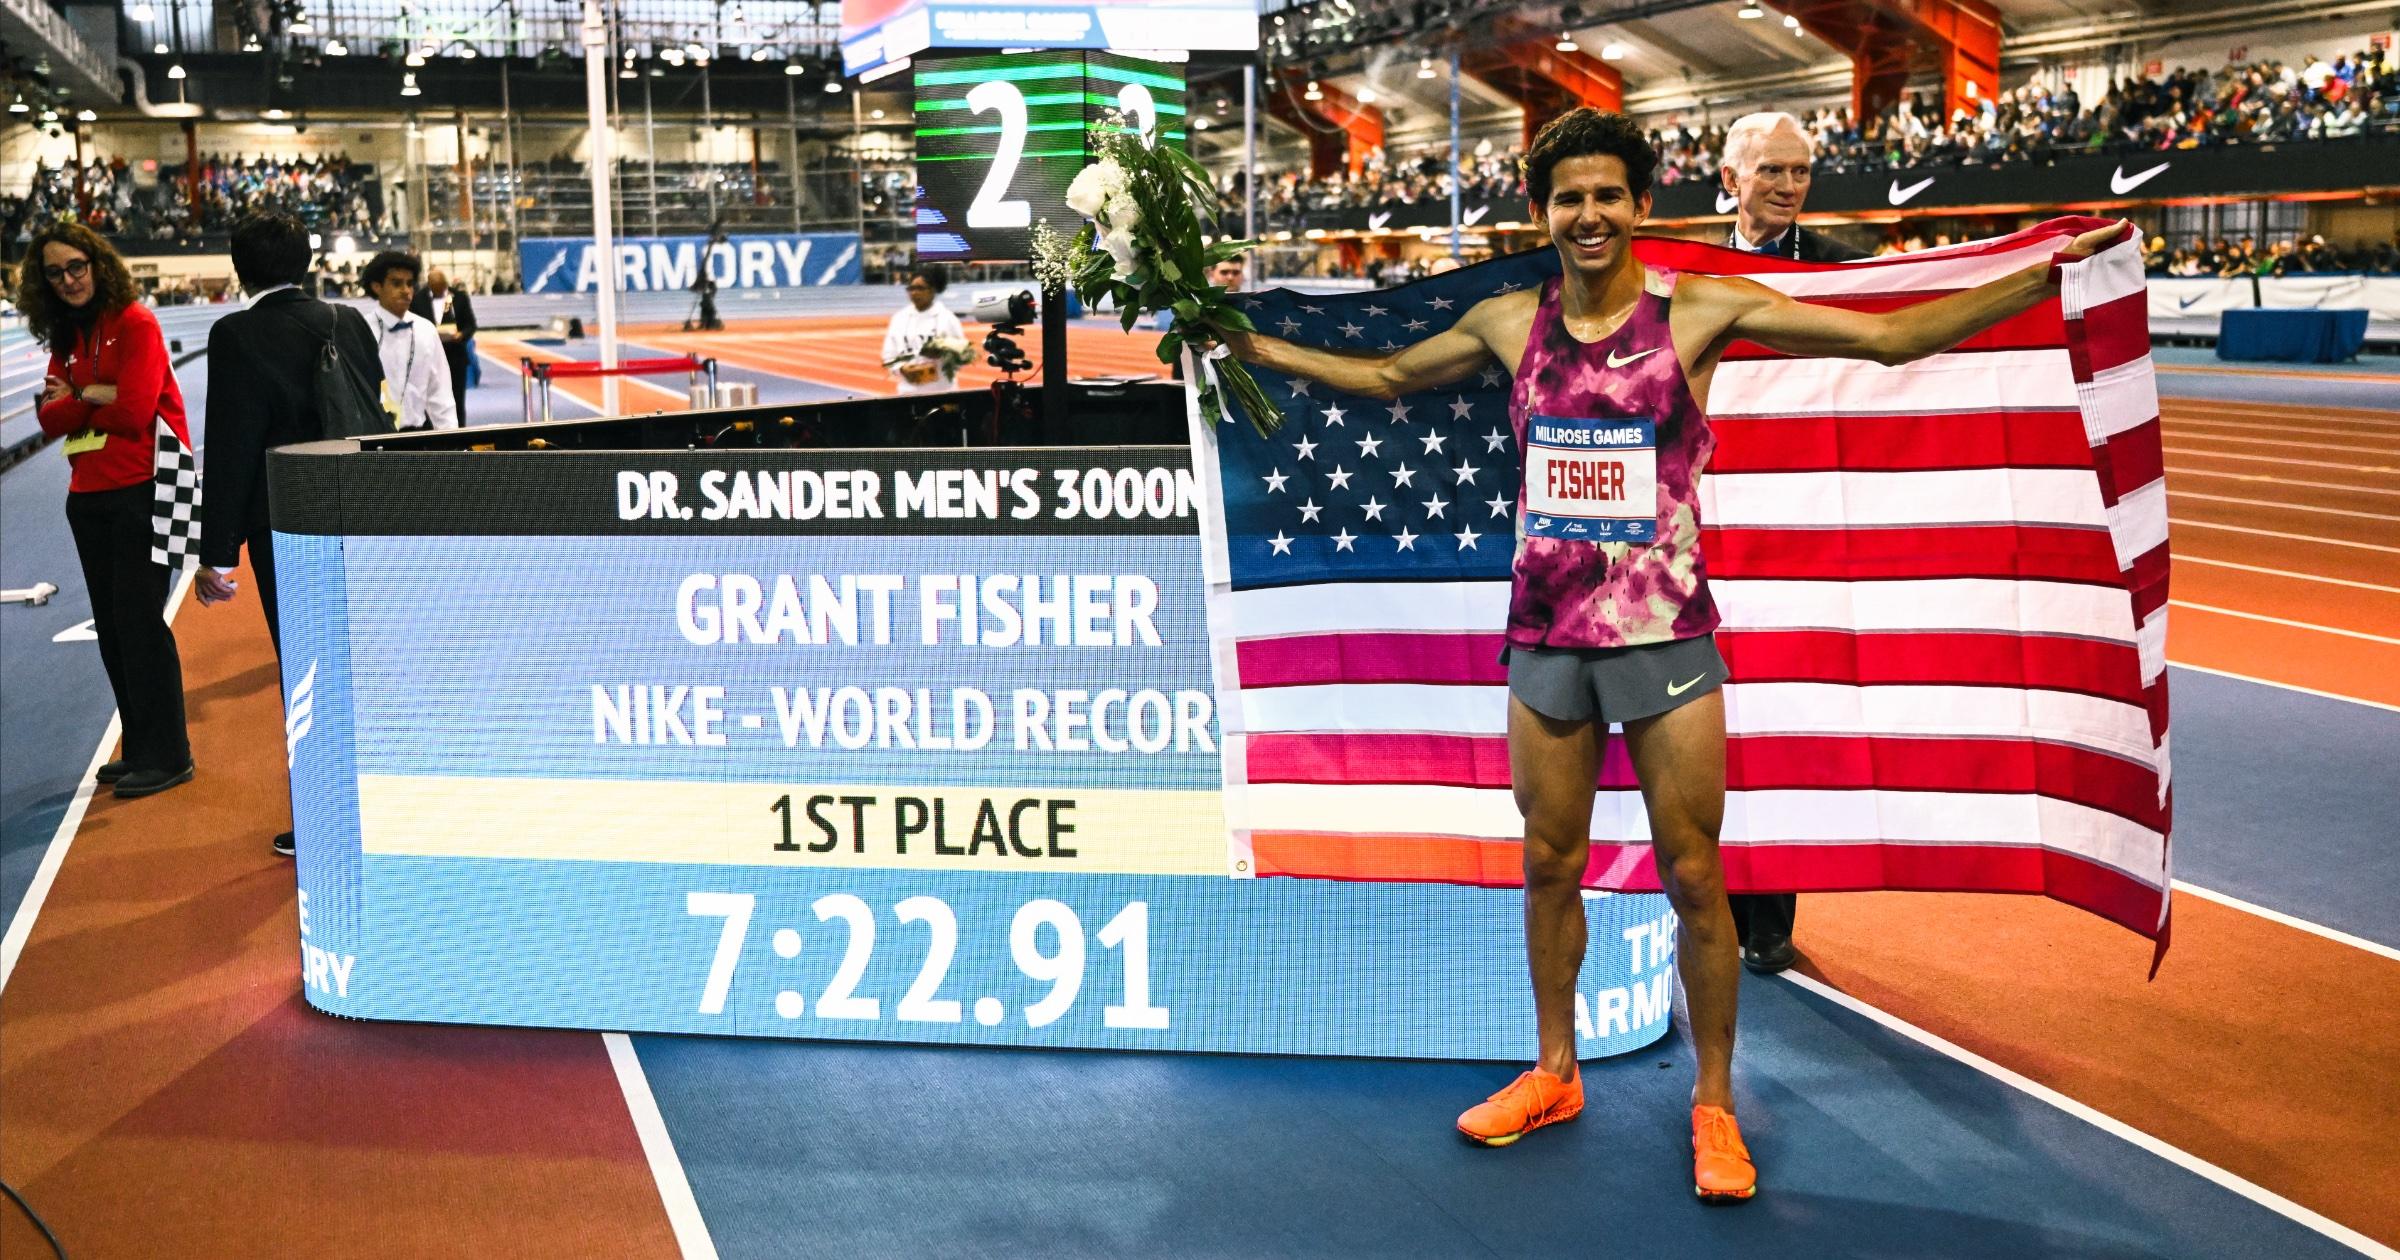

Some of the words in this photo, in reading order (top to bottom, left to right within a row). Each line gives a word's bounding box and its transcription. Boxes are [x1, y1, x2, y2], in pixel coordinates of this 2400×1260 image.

[966, 80, 1031, 228] 2
[575, 240, 812, 293] ARMORY
[1535, 425, 1590, 445] MILLROSE
[1593, 427, 1643, 445] GAMES
[617, 470, 693, 520] DR.
[700, 470, 884, 519] SANDER
[896, 469, 1038, 519] MEN'S
[1547, 459, 1625, 501] FISHER
[676, 573, 904, 647] GRANT
[920, 575, 1162, 648] FISHER
[591, 684, 726, 745] NIKE
[770, 687, 995, 751] WORLD
[769, 794, 877, 854] 1ST
[894, 796, 1077, 858] PLACE
[687, 892, 1170, 1029] 7:22.91
